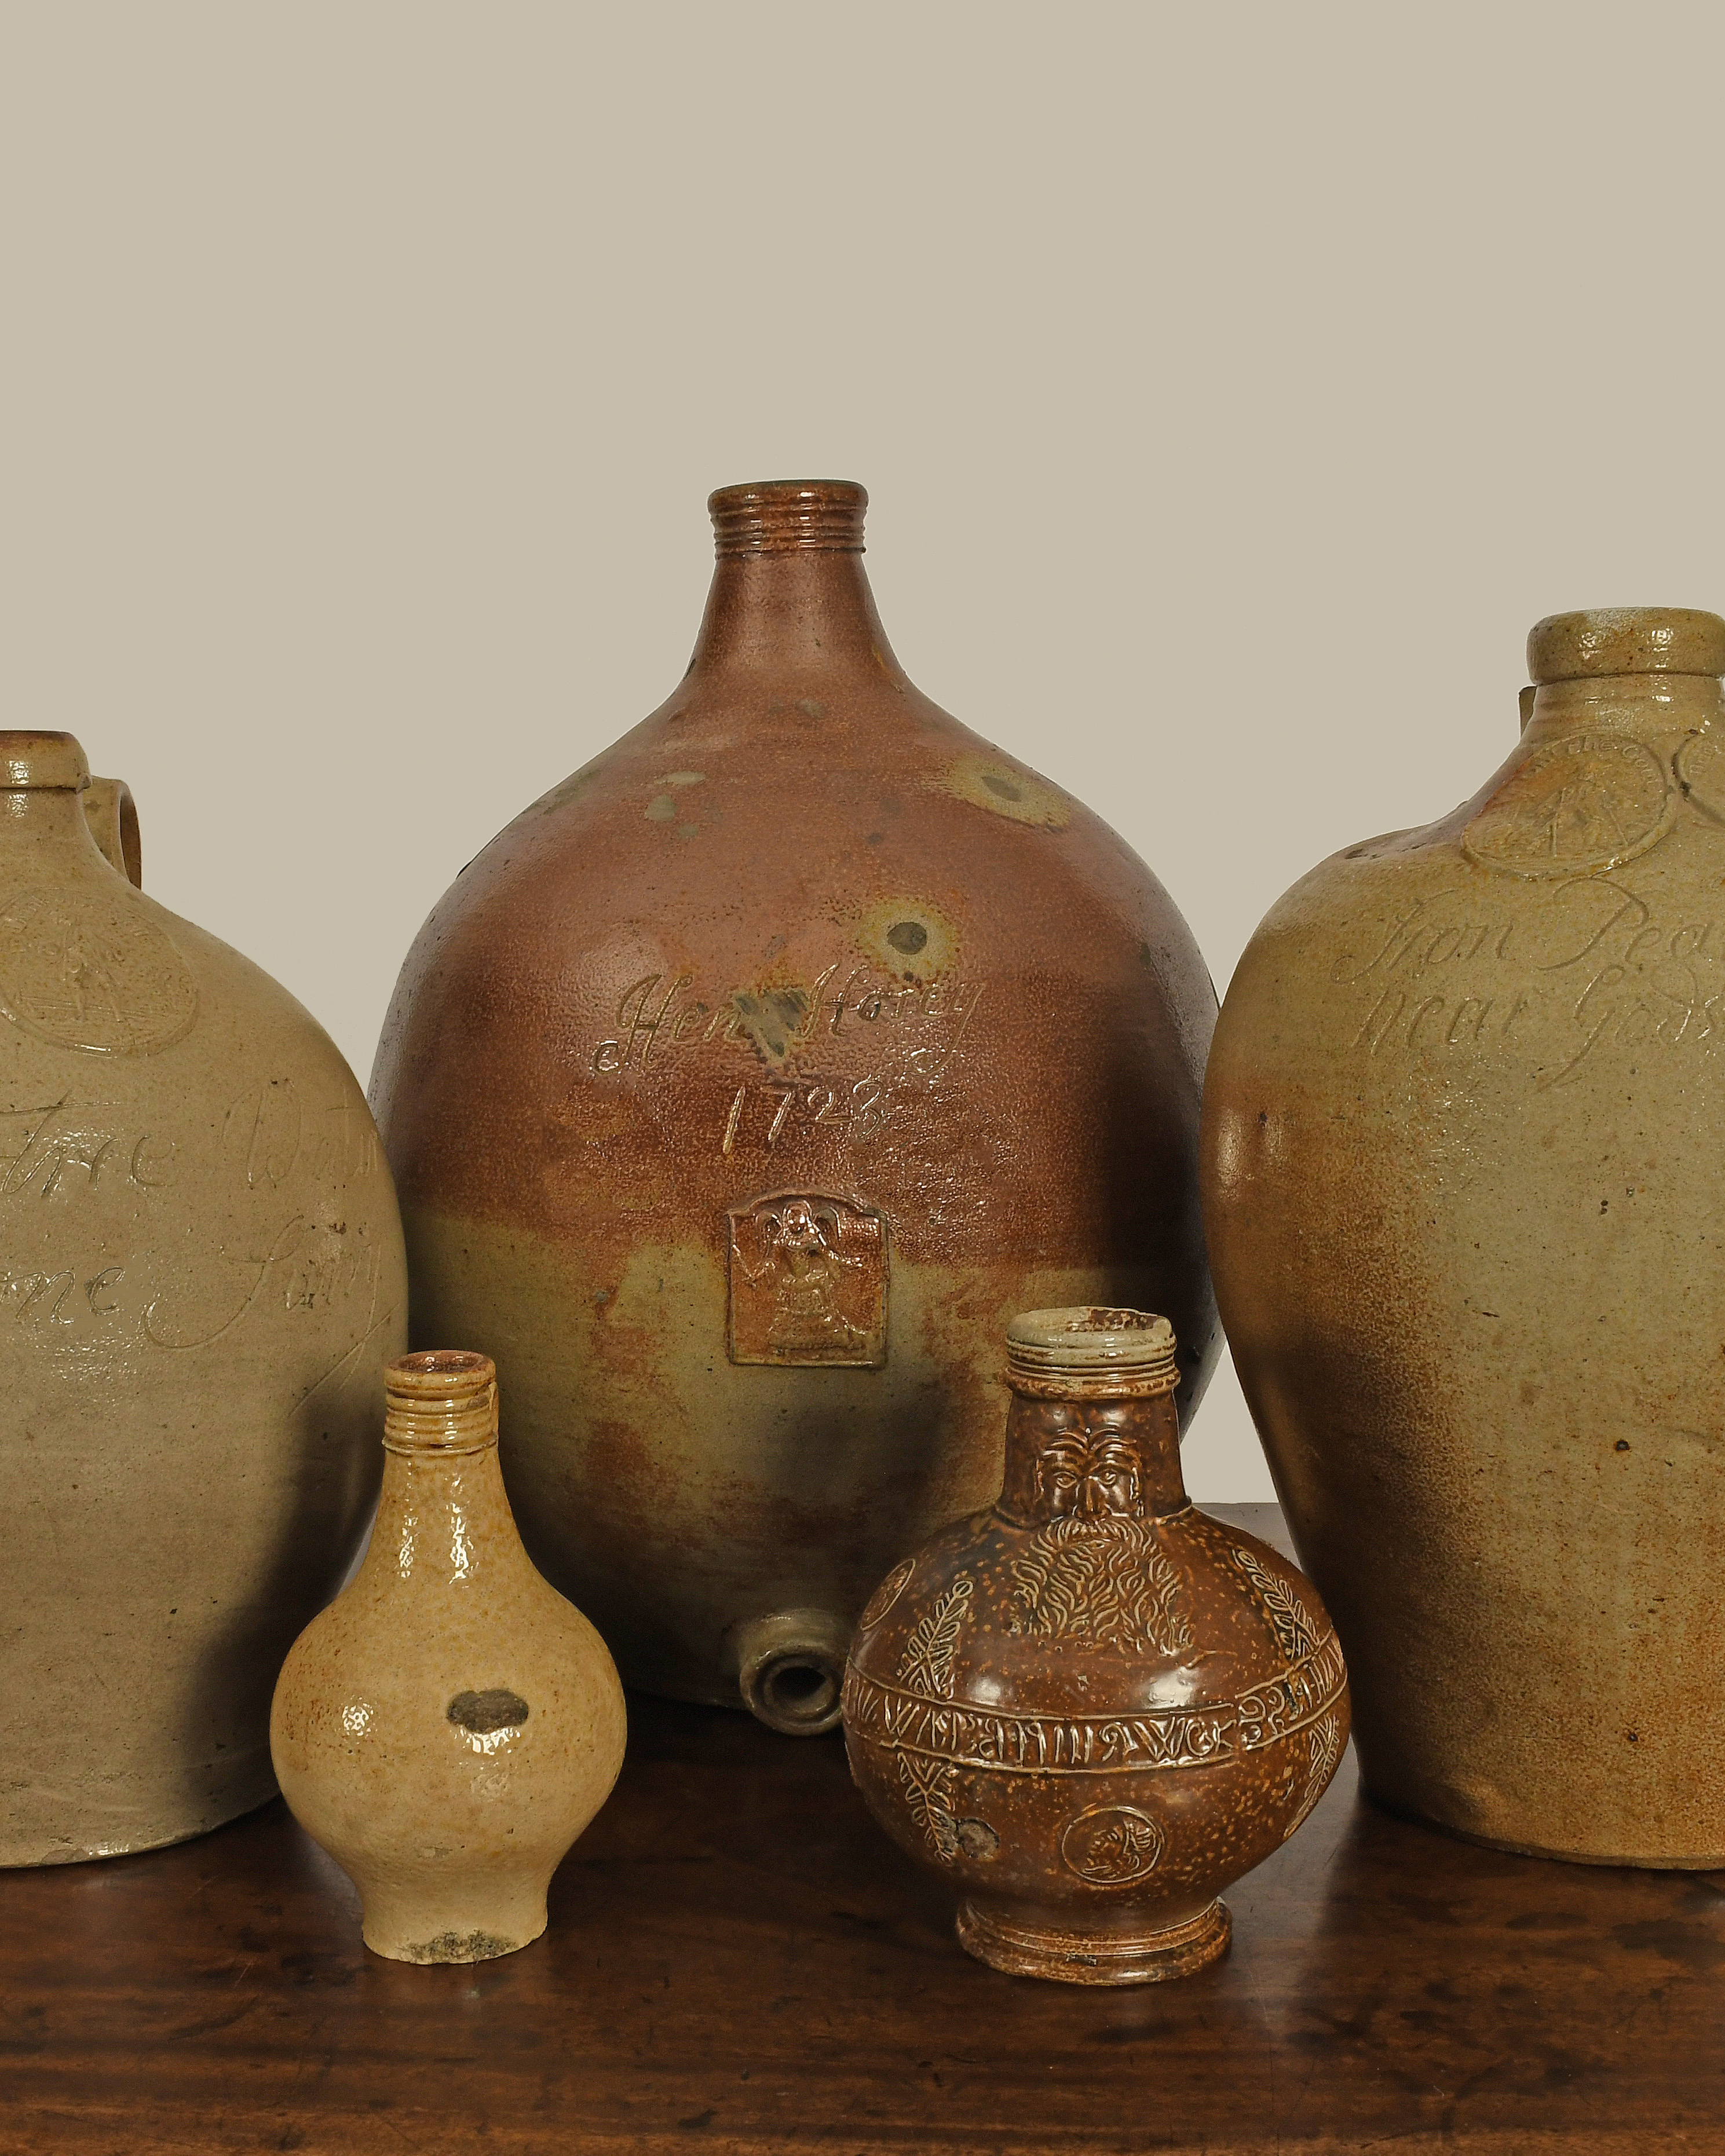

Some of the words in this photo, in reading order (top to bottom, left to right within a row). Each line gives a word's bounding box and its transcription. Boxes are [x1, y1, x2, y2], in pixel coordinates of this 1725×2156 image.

[1535, 877, 1725, 972] Pea
[722, 1074, 886, 1154] 1723
[0, 1265, 126, 1326] ne
